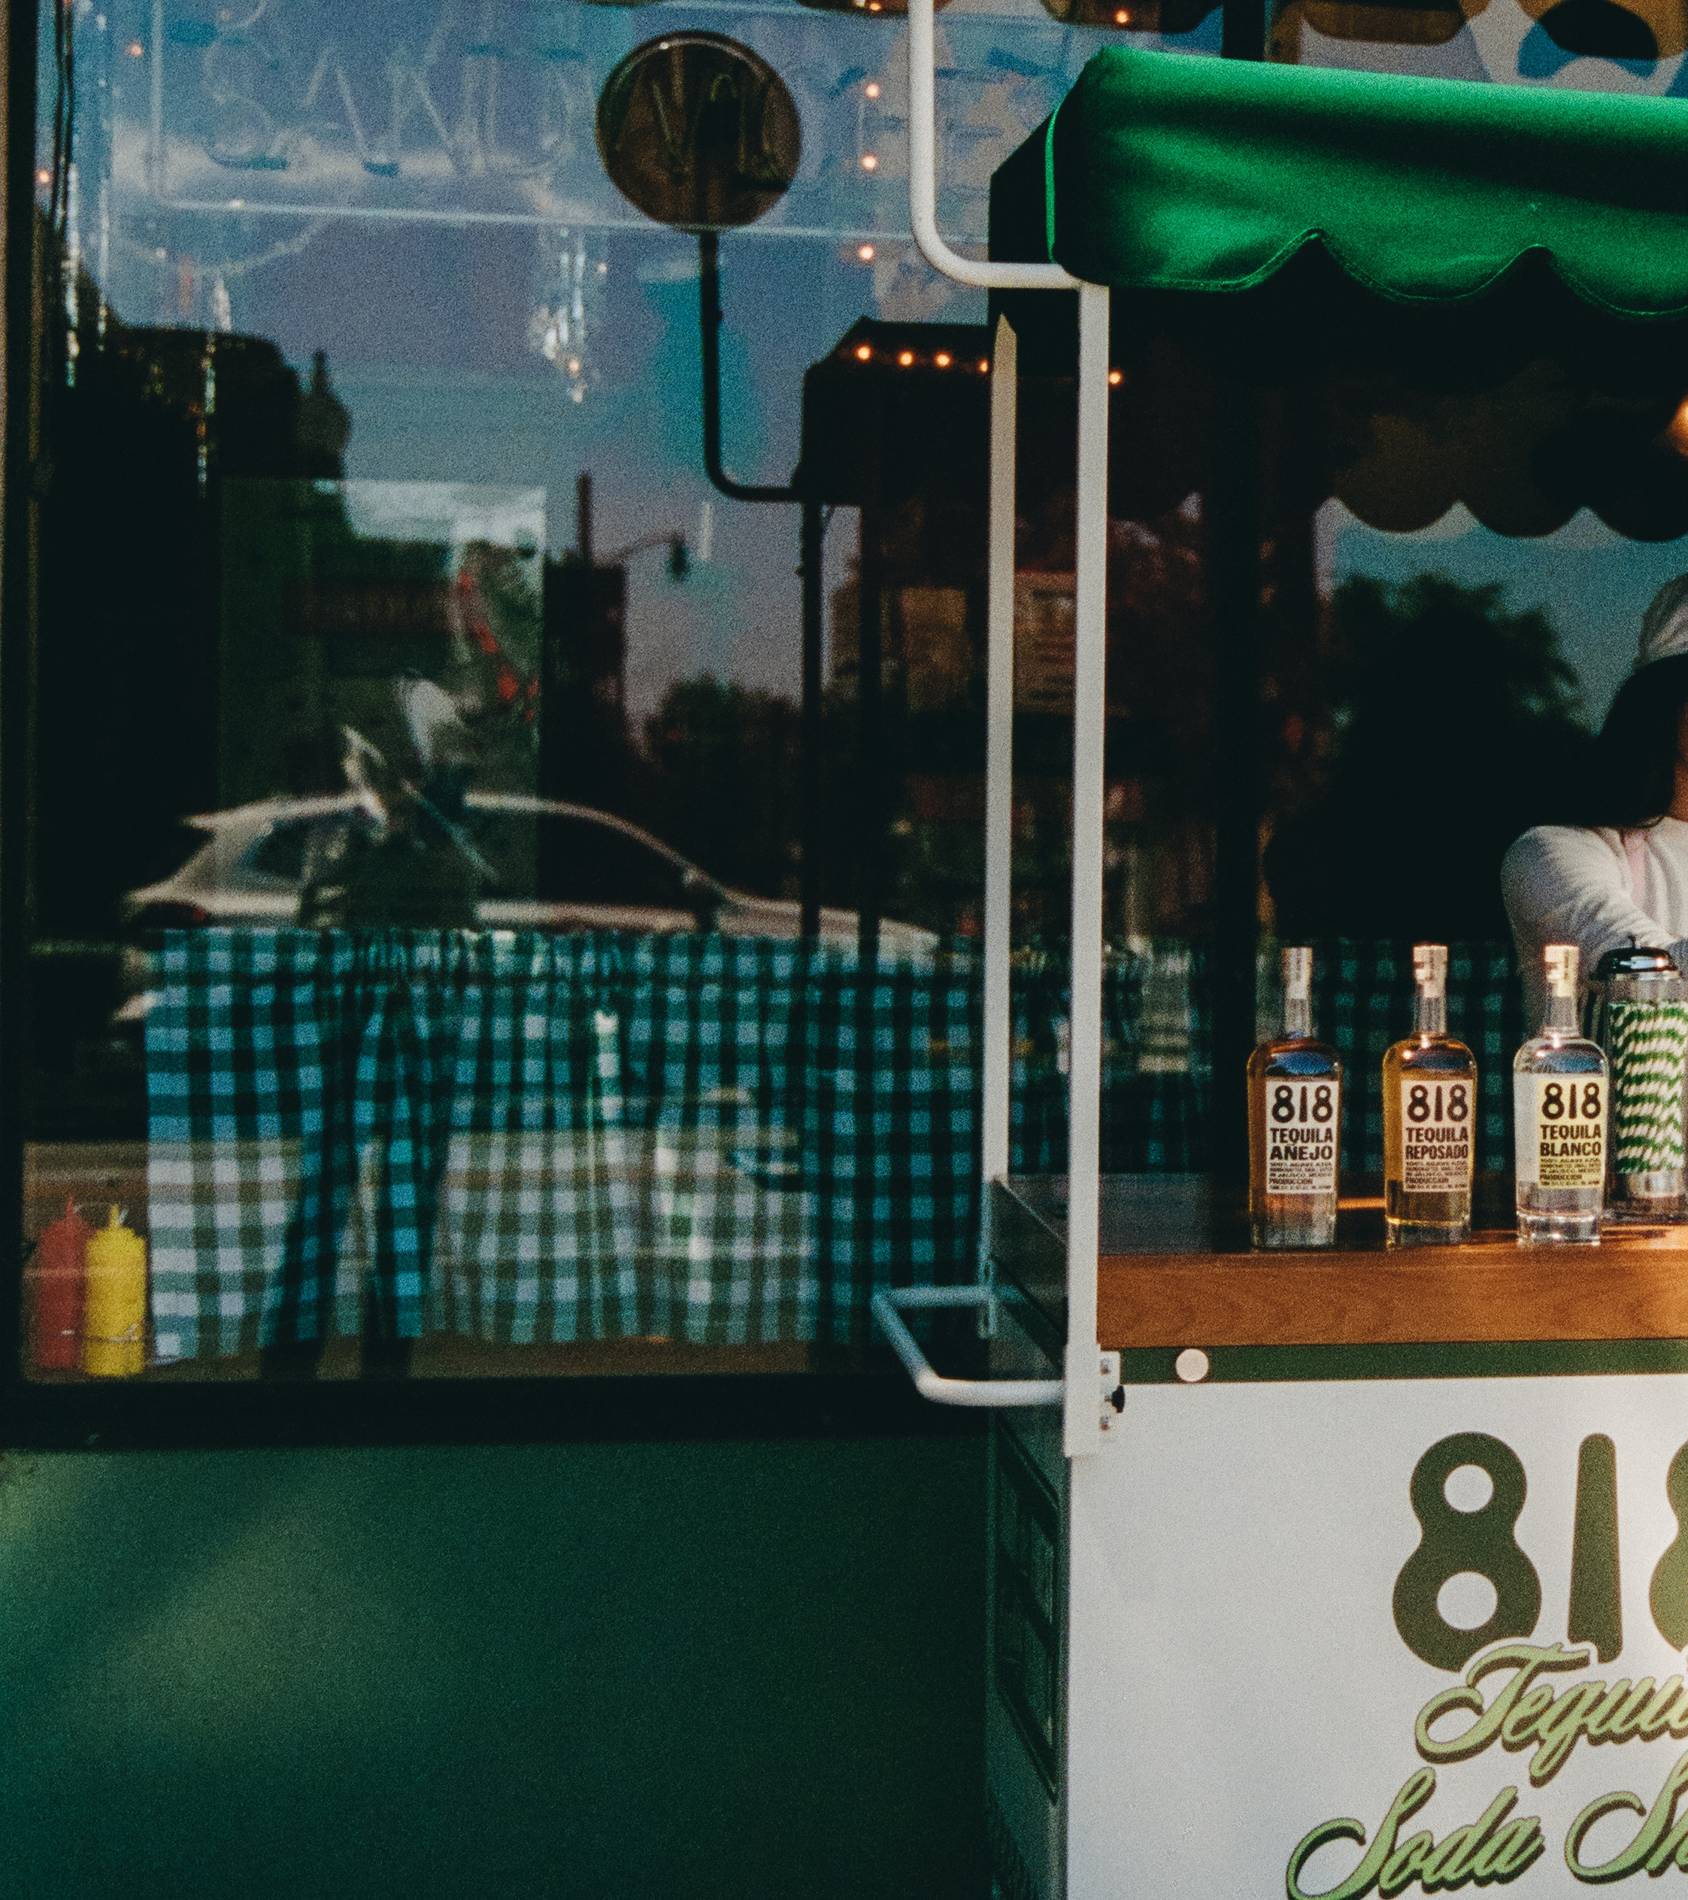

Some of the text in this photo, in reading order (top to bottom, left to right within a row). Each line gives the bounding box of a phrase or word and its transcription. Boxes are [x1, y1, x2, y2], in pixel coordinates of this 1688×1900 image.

[1272, 1085, 1333, 1123] 818
[1407, 1084, 1469, 1123] 818
[1541, 1082, 1602, 1121] 818
[1269, 1127, 1333, 1146] TEQUILA
[1405, 1126, 1469, 1144] TEQUILA
[1540, 1124, 1602, 1141] TEQUILA
[1405, 1143, 1469, 1160] REPOSADO
[1540, 1141, 1602, 1157] BLANCO
[1285, 1766, 1547, 1900] Soda
